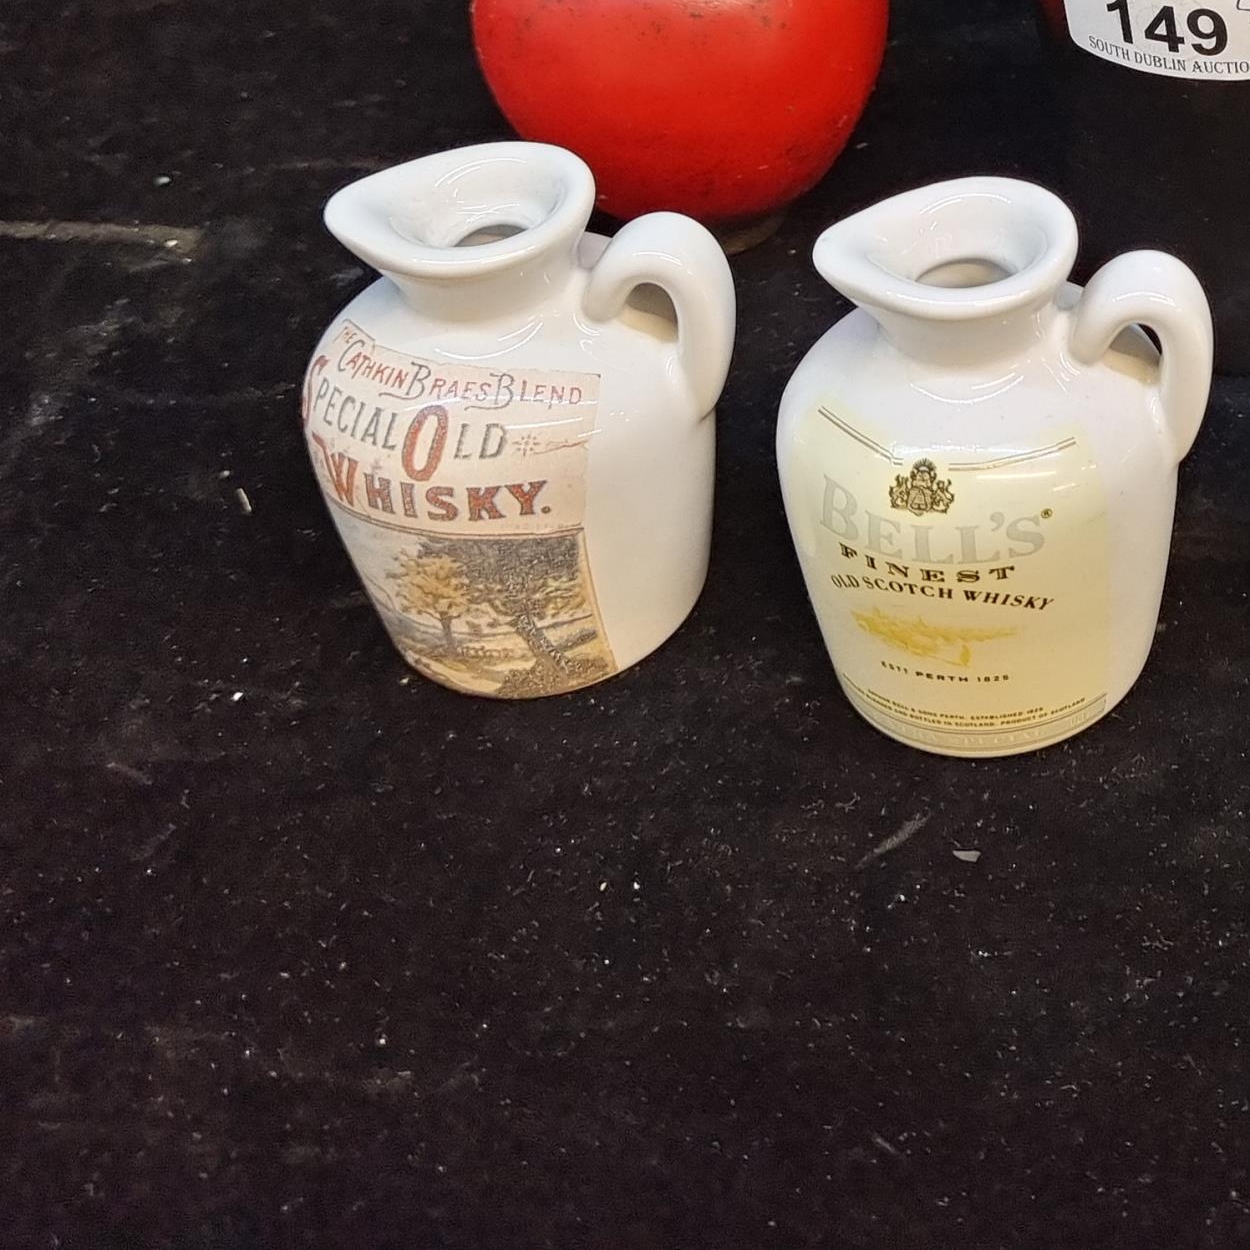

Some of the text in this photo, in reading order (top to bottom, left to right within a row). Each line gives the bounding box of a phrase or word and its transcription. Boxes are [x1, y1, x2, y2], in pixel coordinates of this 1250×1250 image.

[1088, 35, 1131, 61] SOUTH
[1134, 51, 1187, 72] DUBLIN
[338, 339, 583, 411] CATHKIN BRAES BLEND
[401, 404, 507, 482] OLD
[312, 432, 552, 522] WHISKY.
[819, 474, 1045, 565] BELL'S
[838, 542, 1016, 583] FINEST
[831, 574, 1056, 611] OLD SCOTCH WHISKY
[914, 670, 969, 683] PERTH
